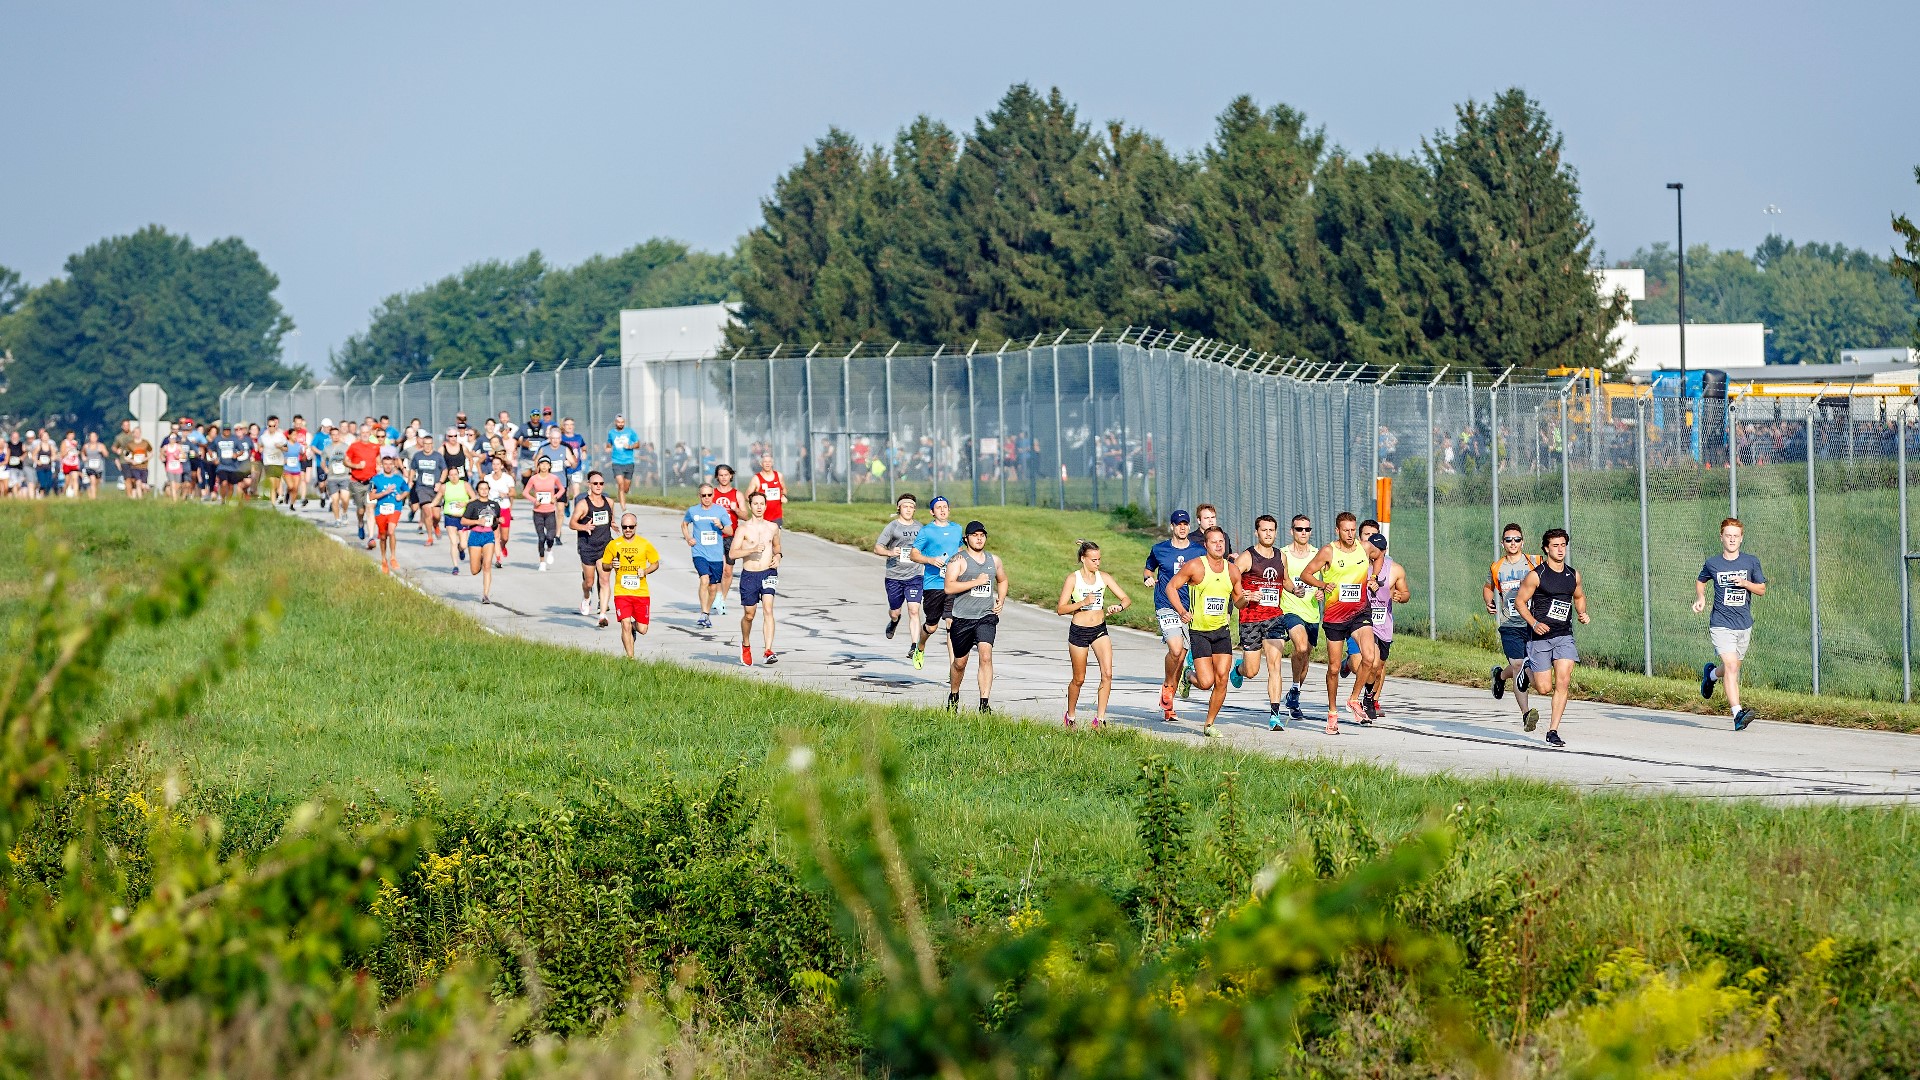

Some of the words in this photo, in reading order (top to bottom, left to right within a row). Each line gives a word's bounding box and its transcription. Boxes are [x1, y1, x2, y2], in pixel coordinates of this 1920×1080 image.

[1341, 589, 1359, 597] 2769
[1726, 594, 1744, 602] 2494
[1551, 606, 1567, 616] 3292
[1371, 612, 1384, 620] 767
